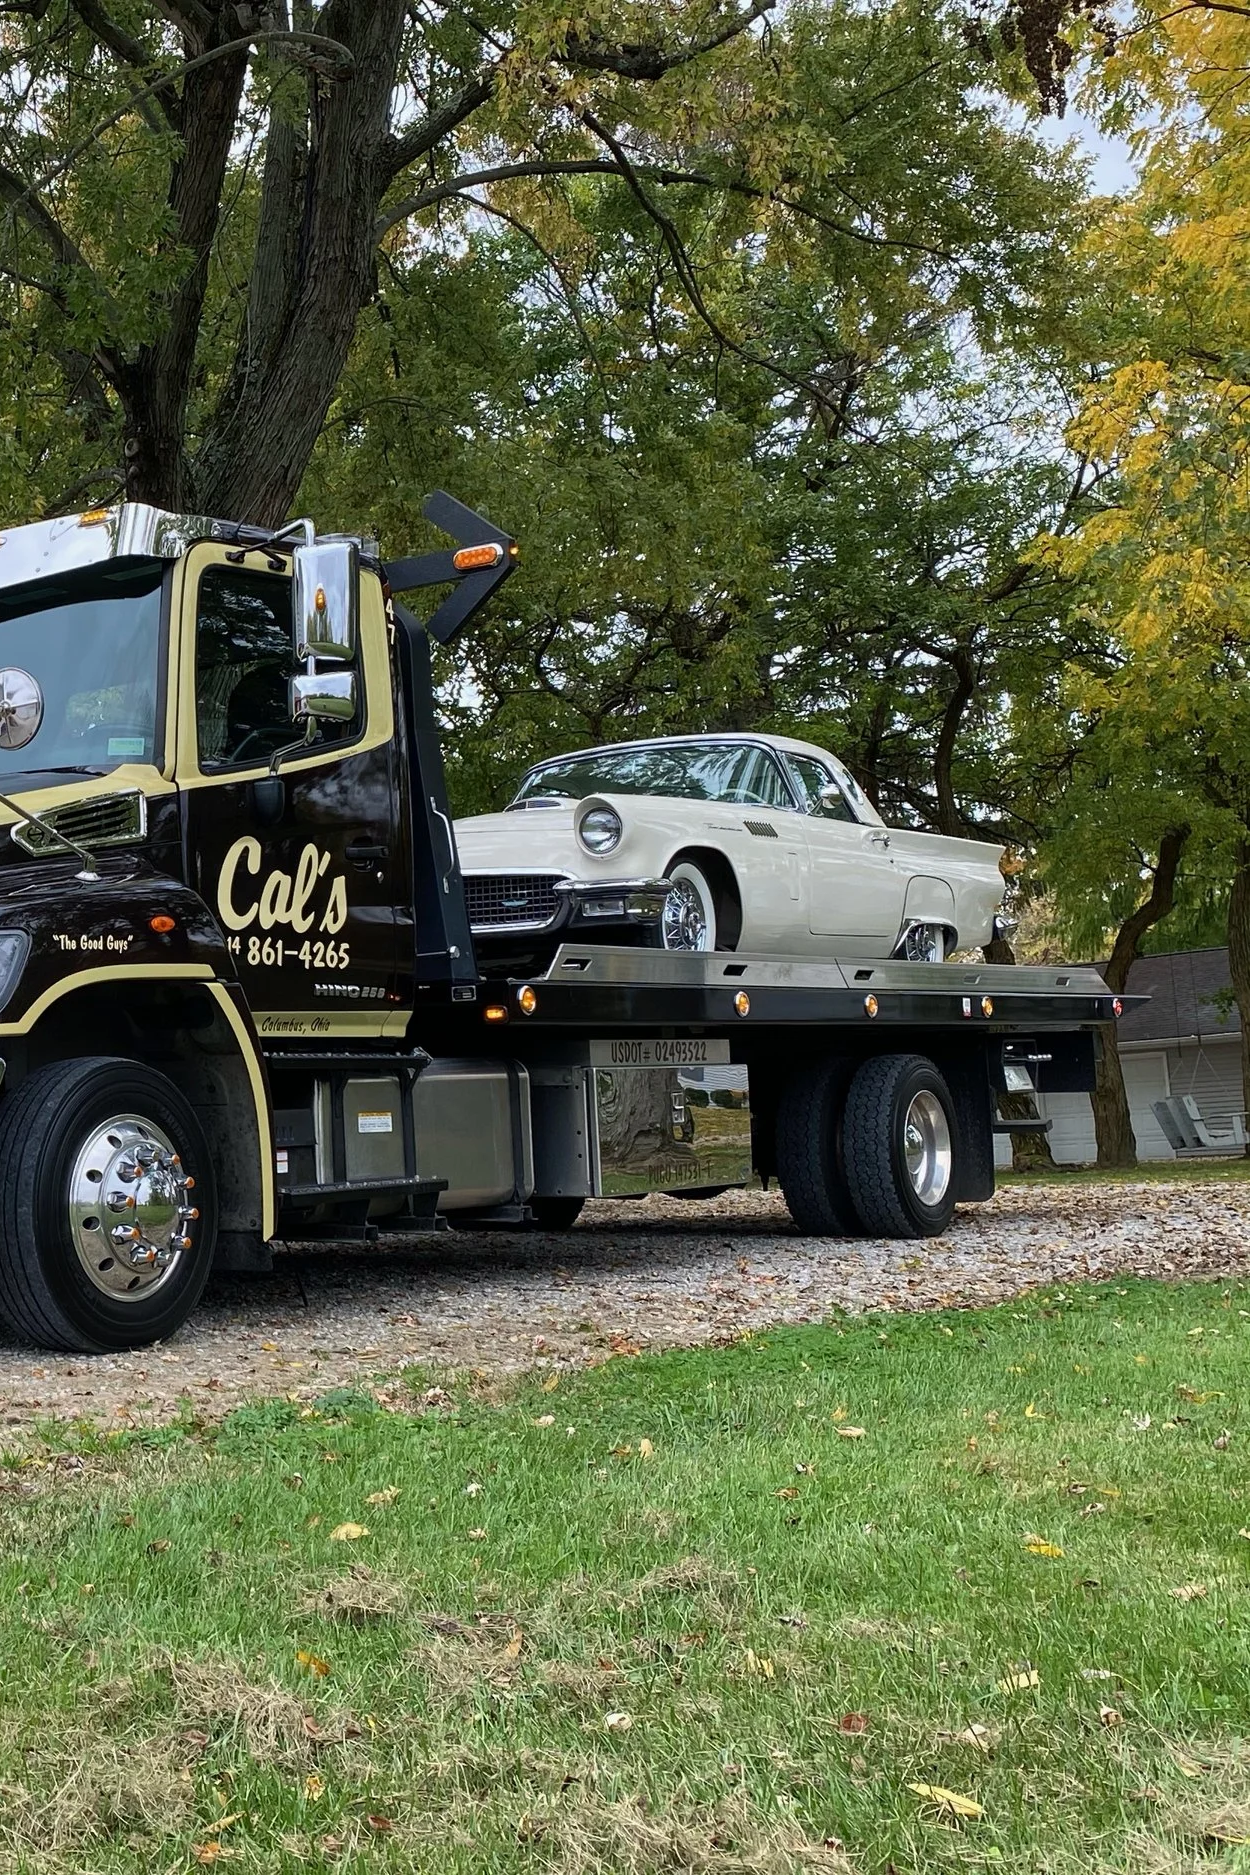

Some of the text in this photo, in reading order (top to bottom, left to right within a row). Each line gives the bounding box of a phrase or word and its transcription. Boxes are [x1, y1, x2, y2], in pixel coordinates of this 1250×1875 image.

[217, 835, 348, 935] Cal's
[80, 934, 104, 951] Good
[247, 936, 350, 970] 861-4265
[314, 983, 361, 998] HINO
[261, 1016, 331, 1035] Columbus, Ohio
[611, 1041, 708, 1064] USDOT# 02493522
